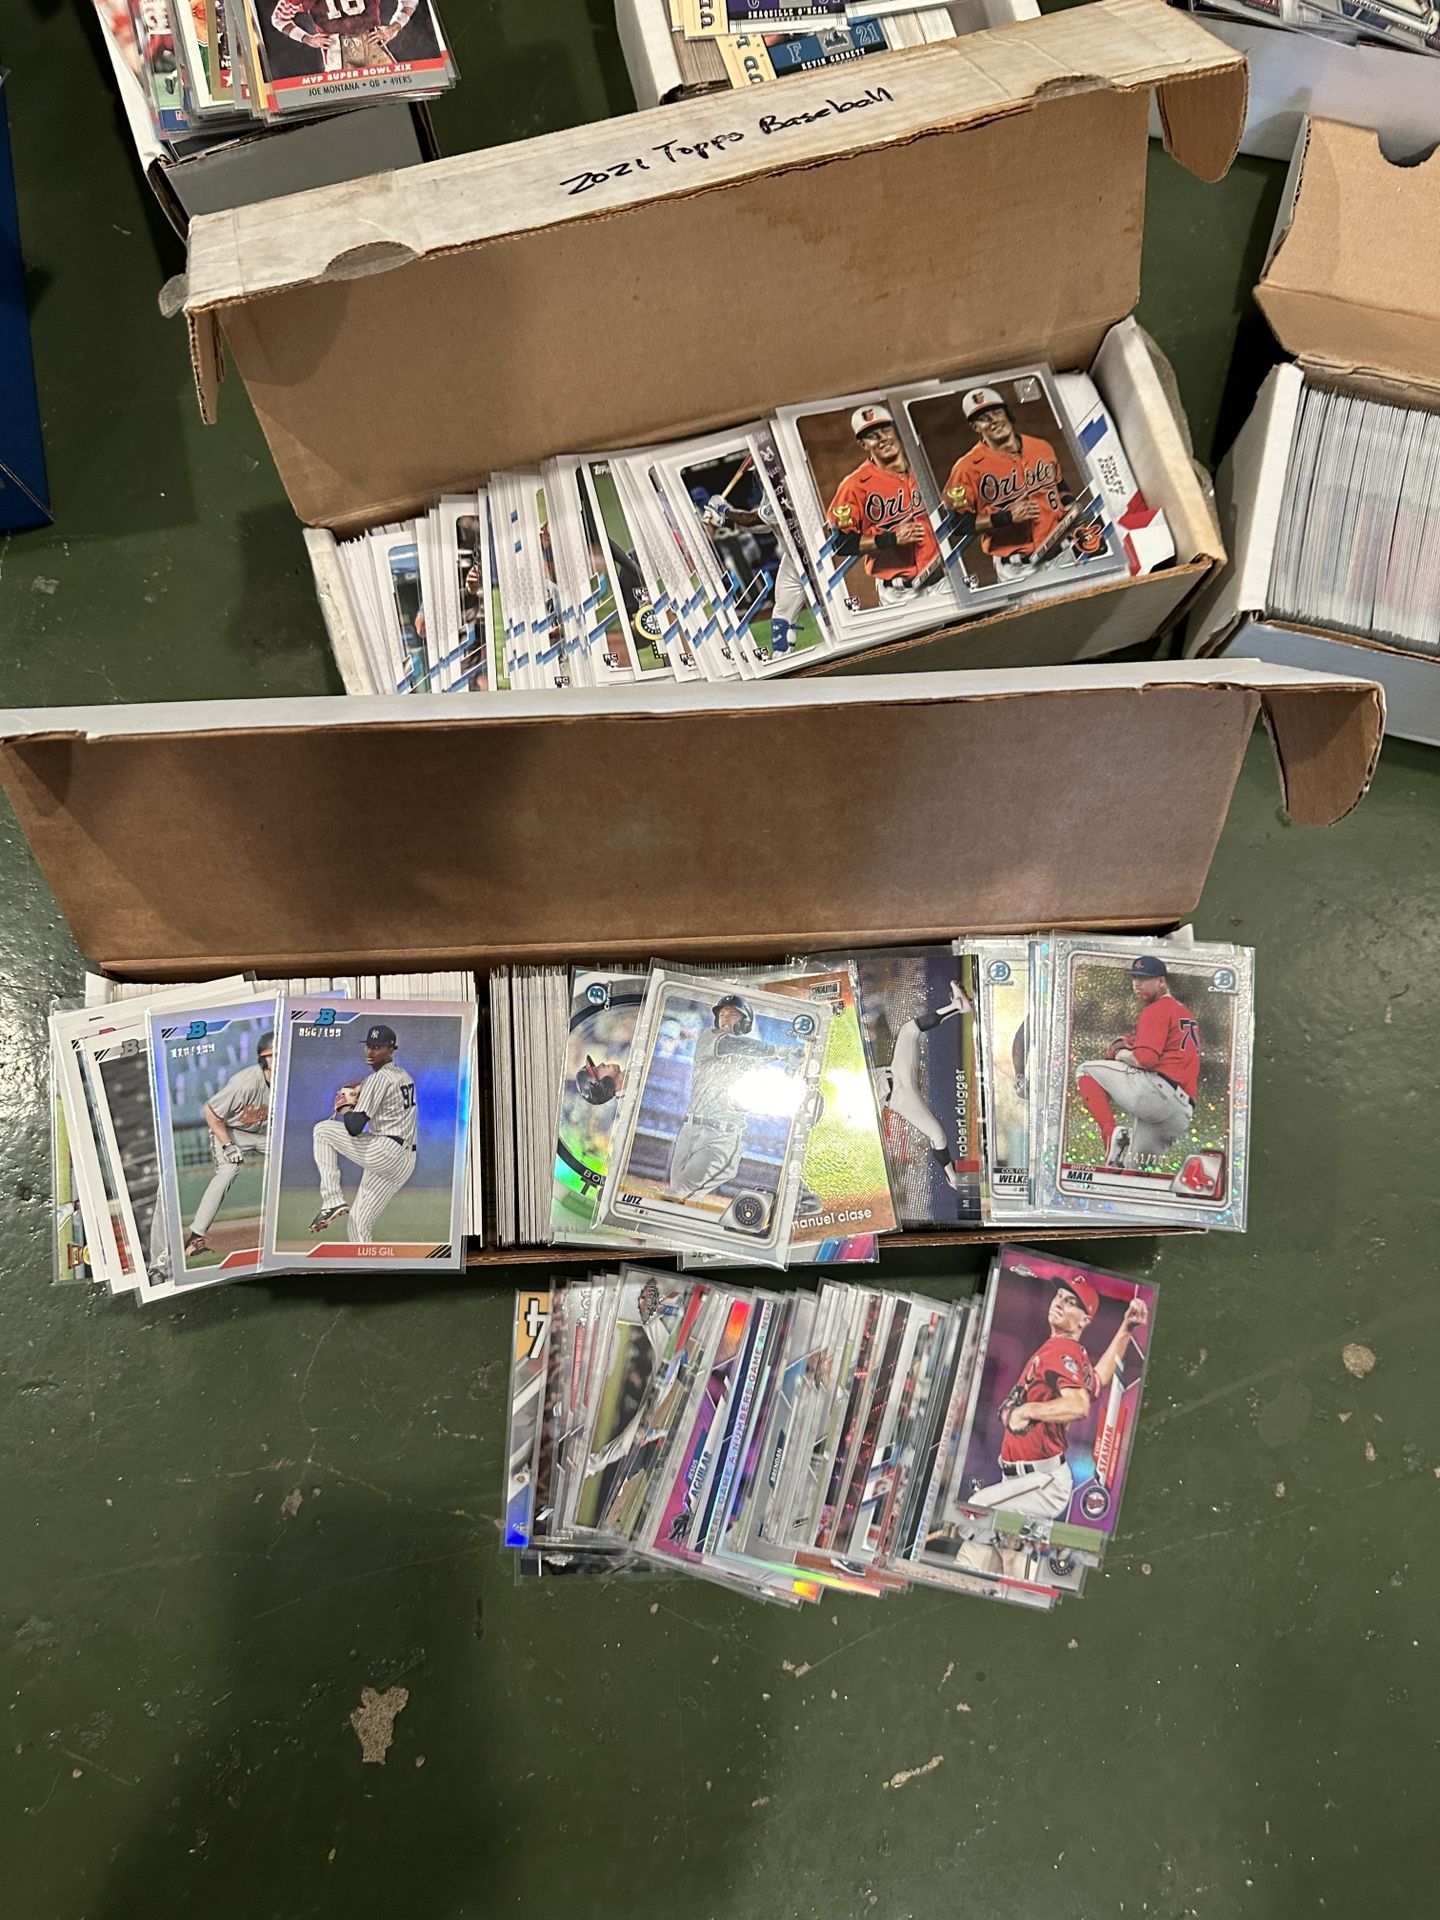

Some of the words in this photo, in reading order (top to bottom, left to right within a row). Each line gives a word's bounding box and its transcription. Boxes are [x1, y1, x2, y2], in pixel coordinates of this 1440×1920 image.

[748, 8, 794, 19] SHAQUILLE
[798, 6, 829, 16] O'NEAL
[855, 23, 881, 46] 21
[801, 57, 827, 71] KEVIN
[830, 47, 866, 63] GARNETT
[302, 74, 324, 85] MVP
[327, 70, 360, 82] SUPER
[363, 66, 392, 77] BOWL
[394, 63, 413, 72] XIX
[309, 87, 322, 97] JOE
[323, 82, 361, 96] MONTANA
[390, 75, 413, 86] 49ERS
[560, 158, 650, 195] 2021
[652, 131, 745, 163] Topps
[759, 87, 893, 133] Baseball
[1048, 490, 1058, 512] 6
[314, 1008, 337, 1027] B
[186, 1020, 208, 1041] B
[955, 1068, 969, 1115] dugger
[956, 1116, 968, 1158] robert
[999, 1174, 1029, 1184] WELKE
[1066, 1171, 1093, 1182] MATA
[621, 1193, 643, 1205] LUTZ
[790, 1213, 835, 1231] manuel
[837, 1207, 873, 1223] clase
[357, 1246, 377, 1257] LUIS
[379, 1246, 396, 1257] GIL
[730, 1386, 754, 1451] NUMBERS
[747, 1346, 764, 1383] GAME
[1097, 1424, 1115, 1473] STASHAK
[687, 1458, 699, 1480] JESUS
[690, 1450, 713, 1498] AGUILAR
[769, 1447, 784, 1482] BRENDAN
